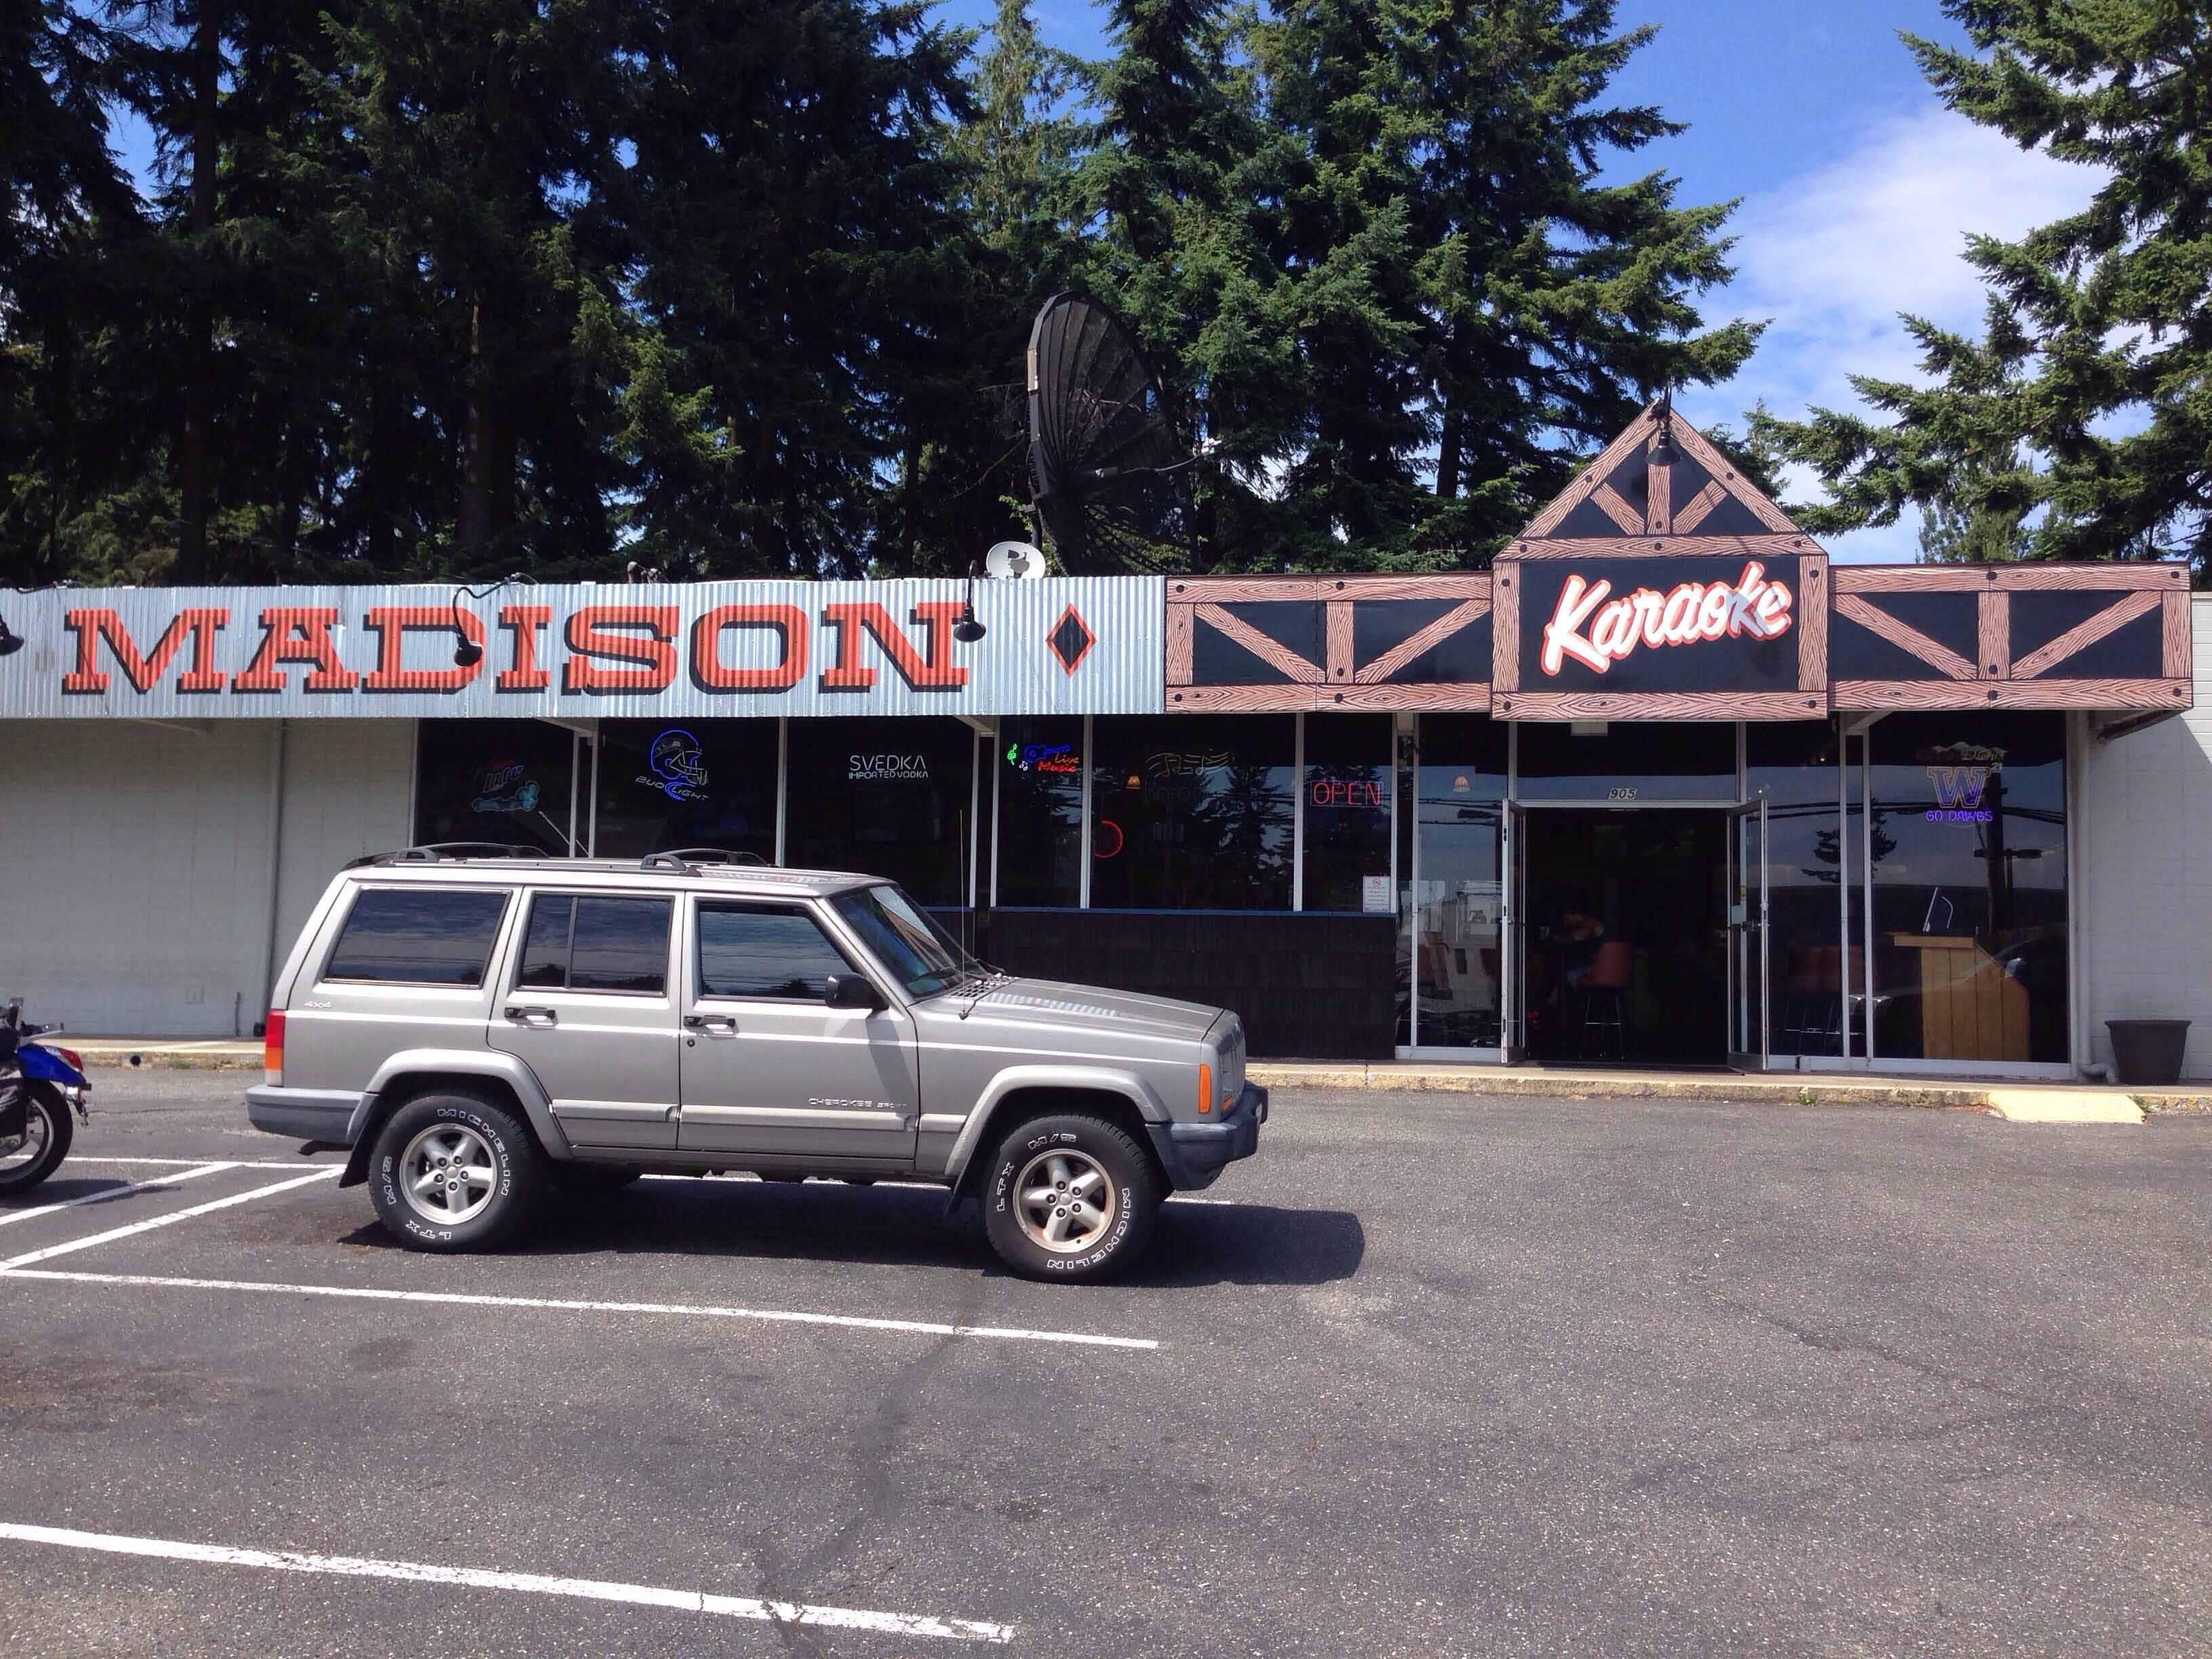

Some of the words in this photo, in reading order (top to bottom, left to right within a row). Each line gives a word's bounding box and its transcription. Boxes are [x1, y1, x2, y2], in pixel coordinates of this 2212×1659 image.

[1541, 560, 1792, 676] Karaoke
[62, 602, 969, 695] MADISON
[850, 755, 926, 771] SVEDKA
[1054, 751, 1080, 764] Live
[848, 771, 896, 779] IMPORTED
[897, 771, 929, 779] VODKA
[1927, 766, 1991, 808] W
[635, 775, 665, 790] BUD
[672, 785, 710, 800] LIGHT
[1313, 781, 1381, 805] OPEN
[1610, 788, 1636, 799] 905
[1925, 810, 1943, 822] GO
[1948, 810, 1994, 822] DAWGS
[808, 1098, 873, 1107] CHEROKEE
[437, 1109, 510, 1196] MICHELIN
[996, 1162, 1015, 1212] LTX
[405, 1220, 451, 1240] LTX
[1046, 1187, 1131, 1269] MICHELIN
